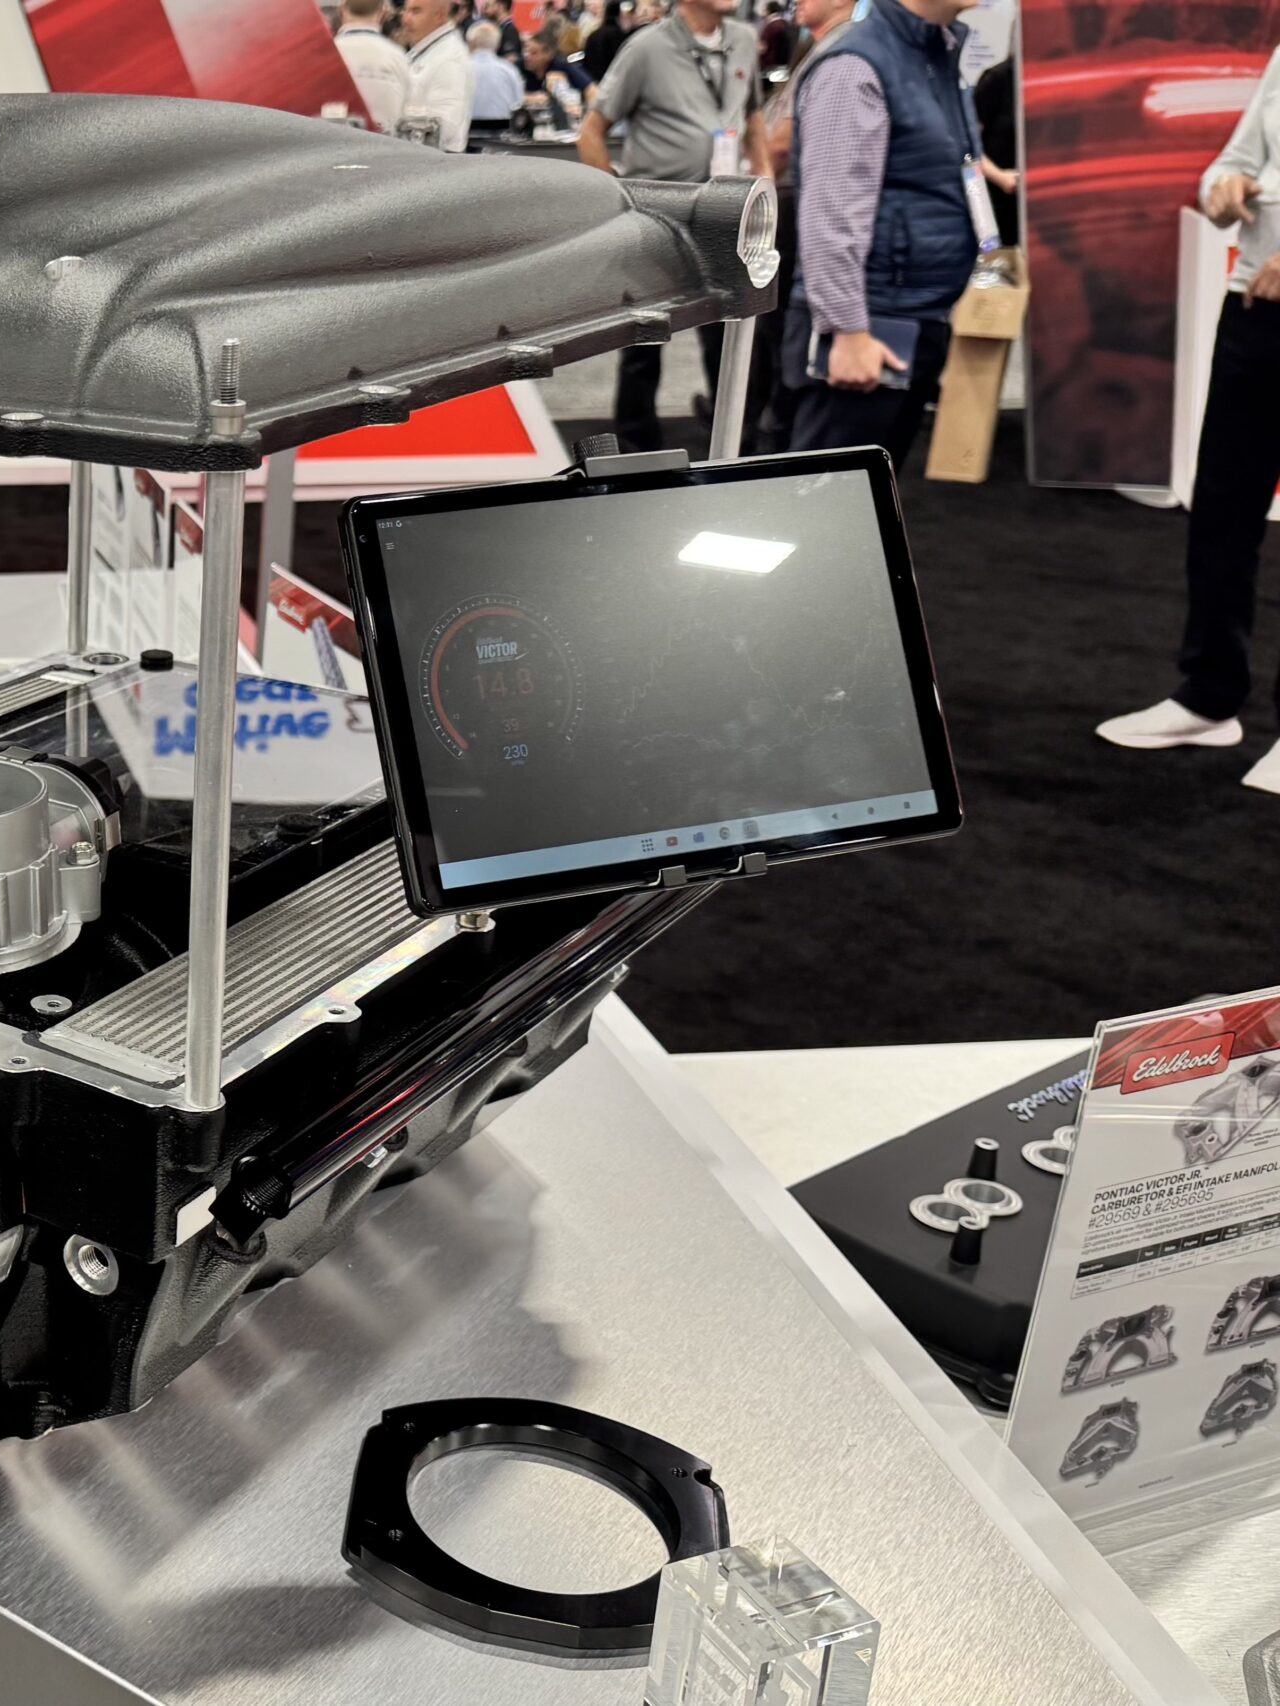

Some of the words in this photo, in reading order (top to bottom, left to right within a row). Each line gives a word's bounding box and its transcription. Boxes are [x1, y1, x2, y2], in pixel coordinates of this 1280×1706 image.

[475, 641, 518, 659] VICTOR
[503, 743, 529, 760] 230
[1132, 1044, 1222, 1083] Edelbrock
[1091, 1188, 1167, 1215] CARBURETOR
[1166, 1186, 1175, 1198] &
[1175, 1182, 1194, 1196] EFI
[1192, 1173, 1233, 1191] INTAKE
[1232, 1161, 1280, 1182] MANIFOL
[1093, 1183, 1144, 1204] PONTIAC
[1145, 1173, 1186, 1192] VICTOR
[1087, 1206, 1142, 1230] #29569
[1141, 1203, 1152, 1218] &
[1154, 1188, 1215, 1214] #295695
